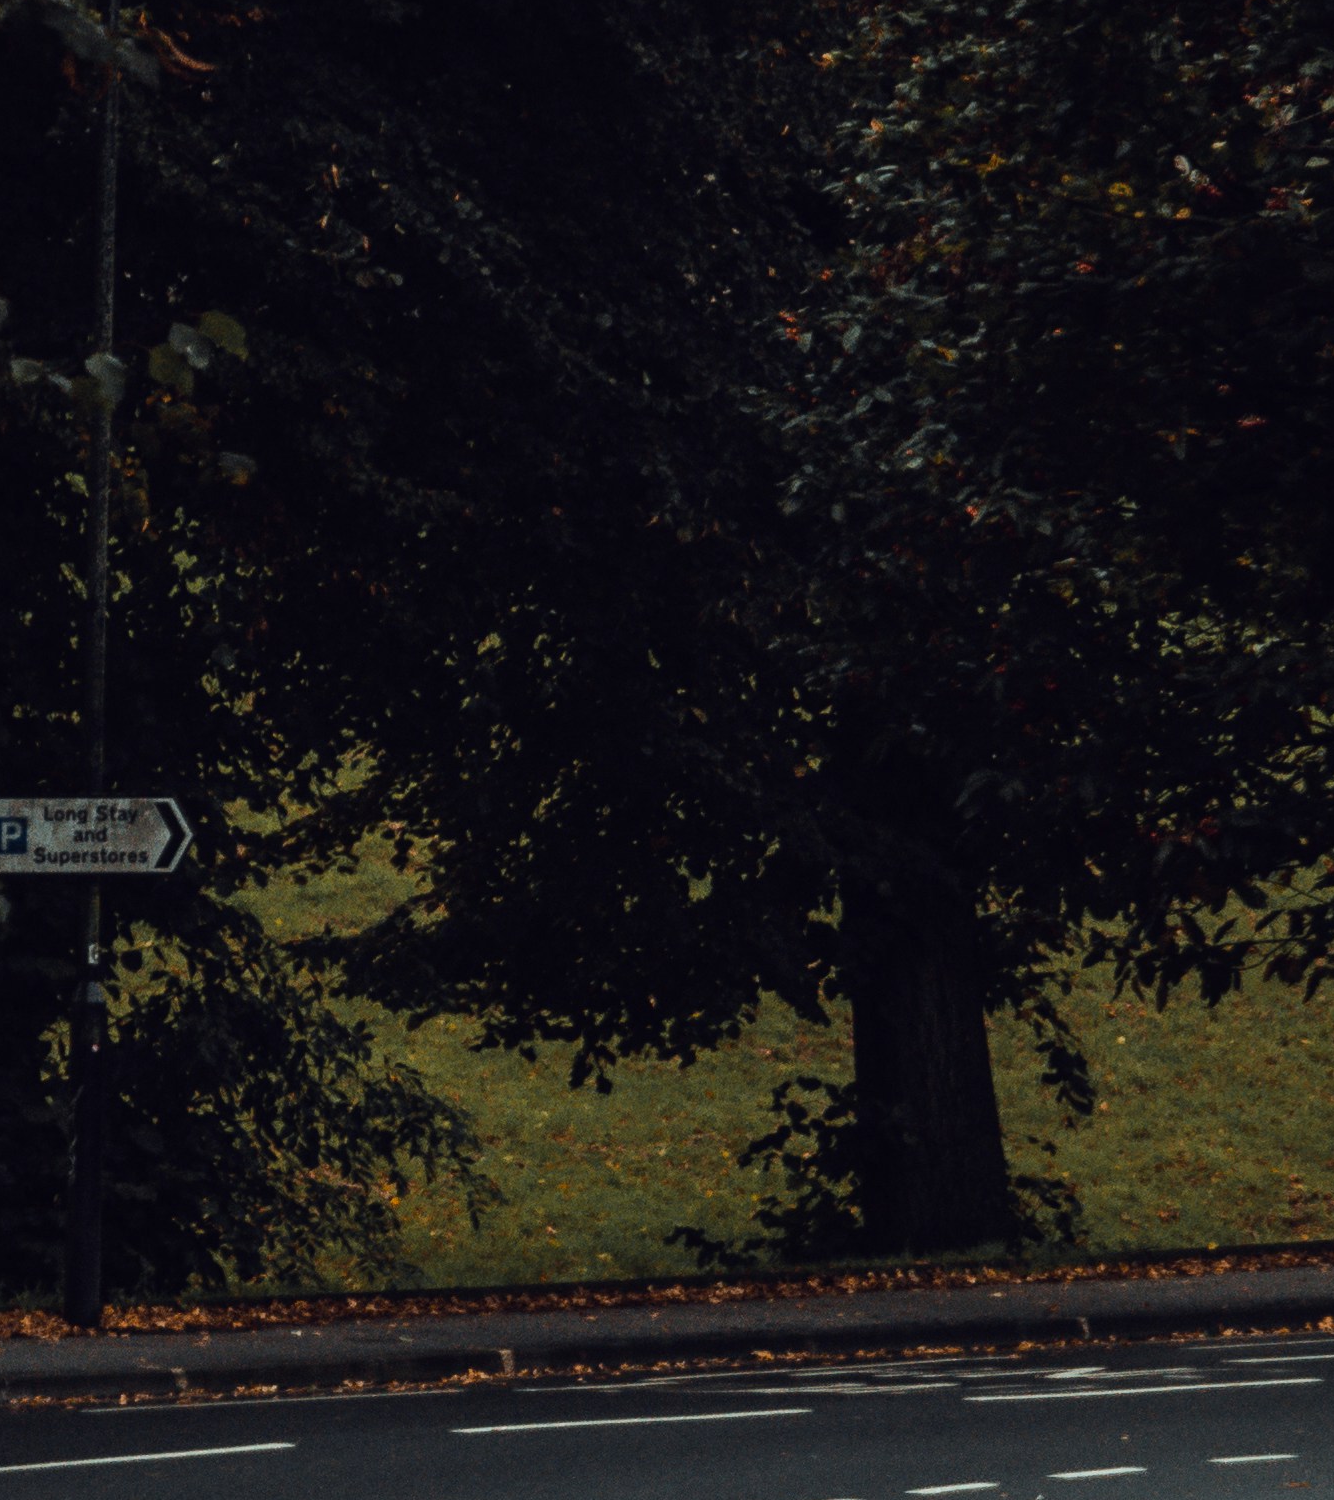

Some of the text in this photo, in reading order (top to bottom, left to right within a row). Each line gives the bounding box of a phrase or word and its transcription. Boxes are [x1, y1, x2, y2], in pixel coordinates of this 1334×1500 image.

[43, 804, 138, 825] Long Stay
[1, 822, 22, 851] P
[73, 827, 108, 842] and
[33, 846, 149, 866] Superstores
